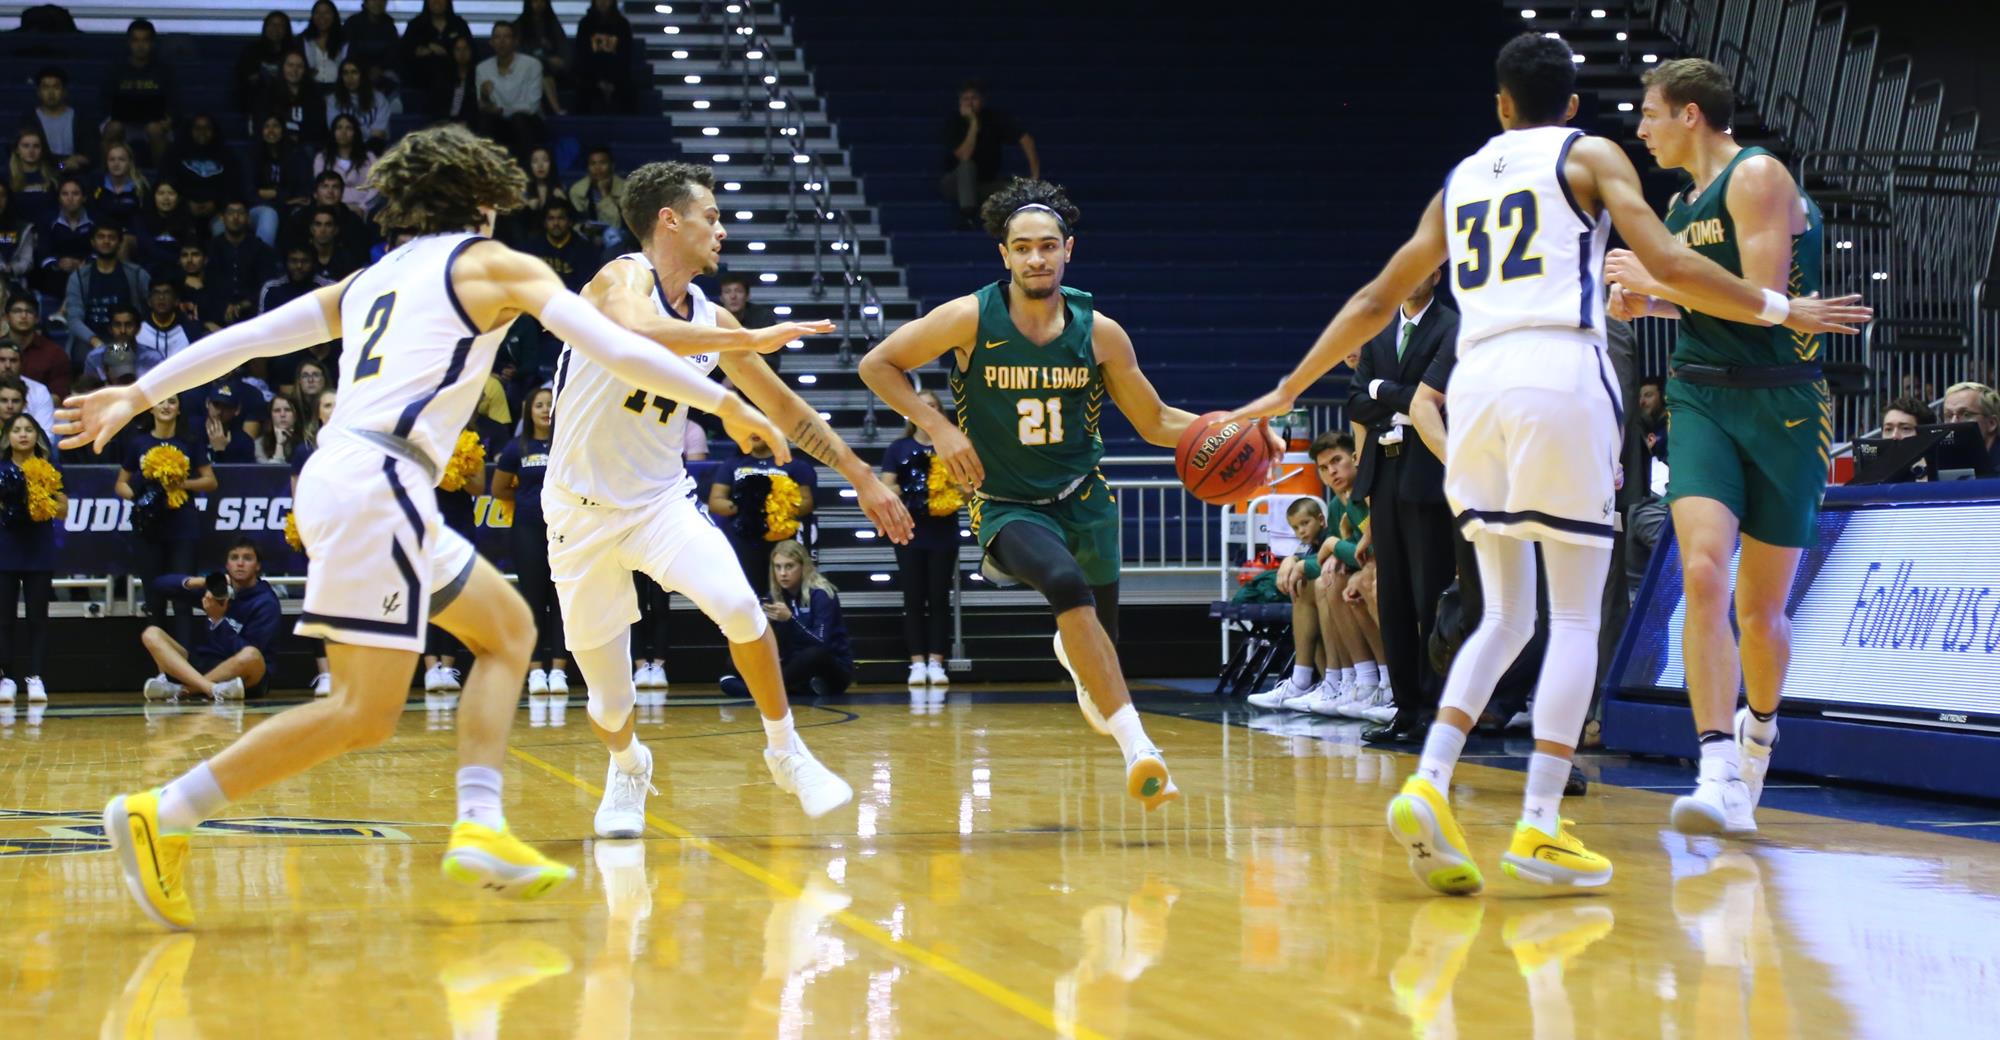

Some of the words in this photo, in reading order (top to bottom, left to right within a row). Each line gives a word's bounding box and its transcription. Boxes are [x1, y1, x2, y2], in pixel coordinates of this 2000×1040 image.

[1455, 188, 1544, 291] 32
[353, 289, 397, 384] 2
[983, 365, 1039, 390] POINT
[1041, 365, 1091, 390] LOMA
[1015, 396, 1065, 446] 21
[1190, 421, 1242, 471] Wilson
[215, 497, 293, 531] SEC
[1842, 559, 1950, 651] Follow
[1941, 586, 1990, 653] us
